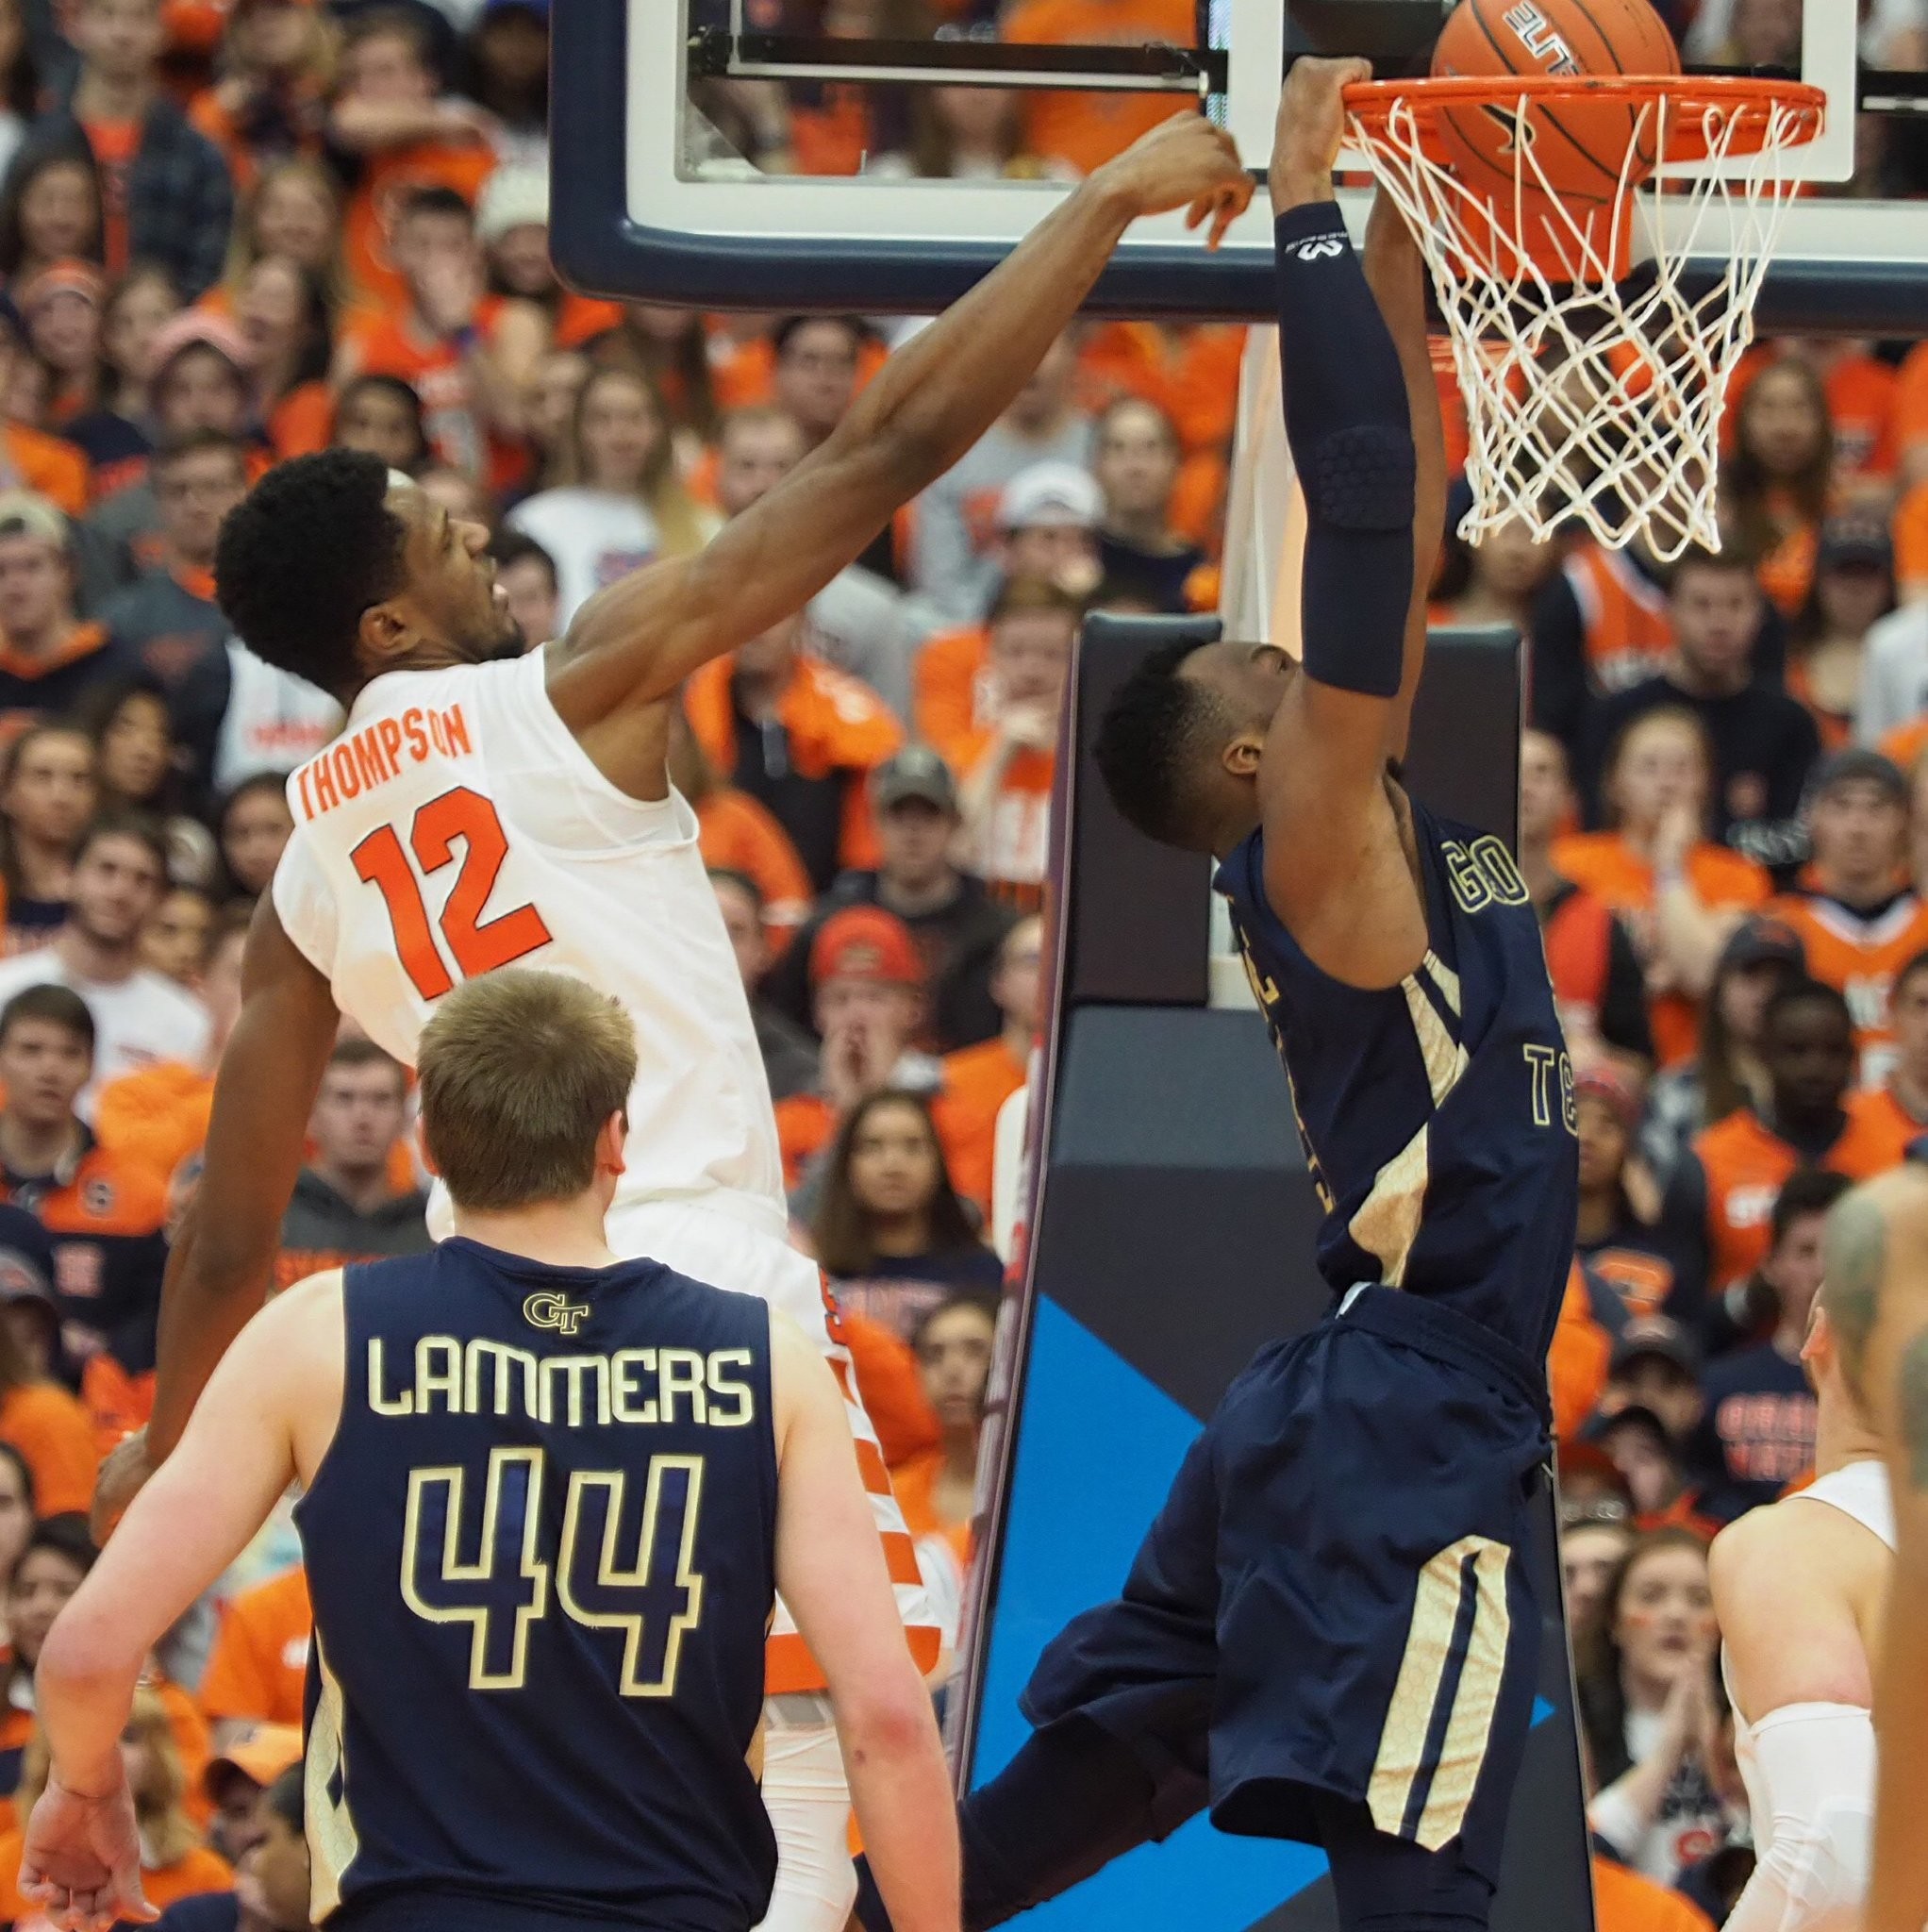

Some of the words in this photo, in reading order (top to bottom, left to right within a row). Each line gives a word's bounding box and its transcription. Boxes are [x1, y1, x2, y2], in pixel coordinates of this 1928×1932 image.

[297, 704, 472, 821] THOMPSON
[349, 786, 554, 1002] 12
[523, 1292, 589, 1335] GT
[368, 1336, 754, 1426] LAMMERS
[400, 1447, 704, 1697] 44
